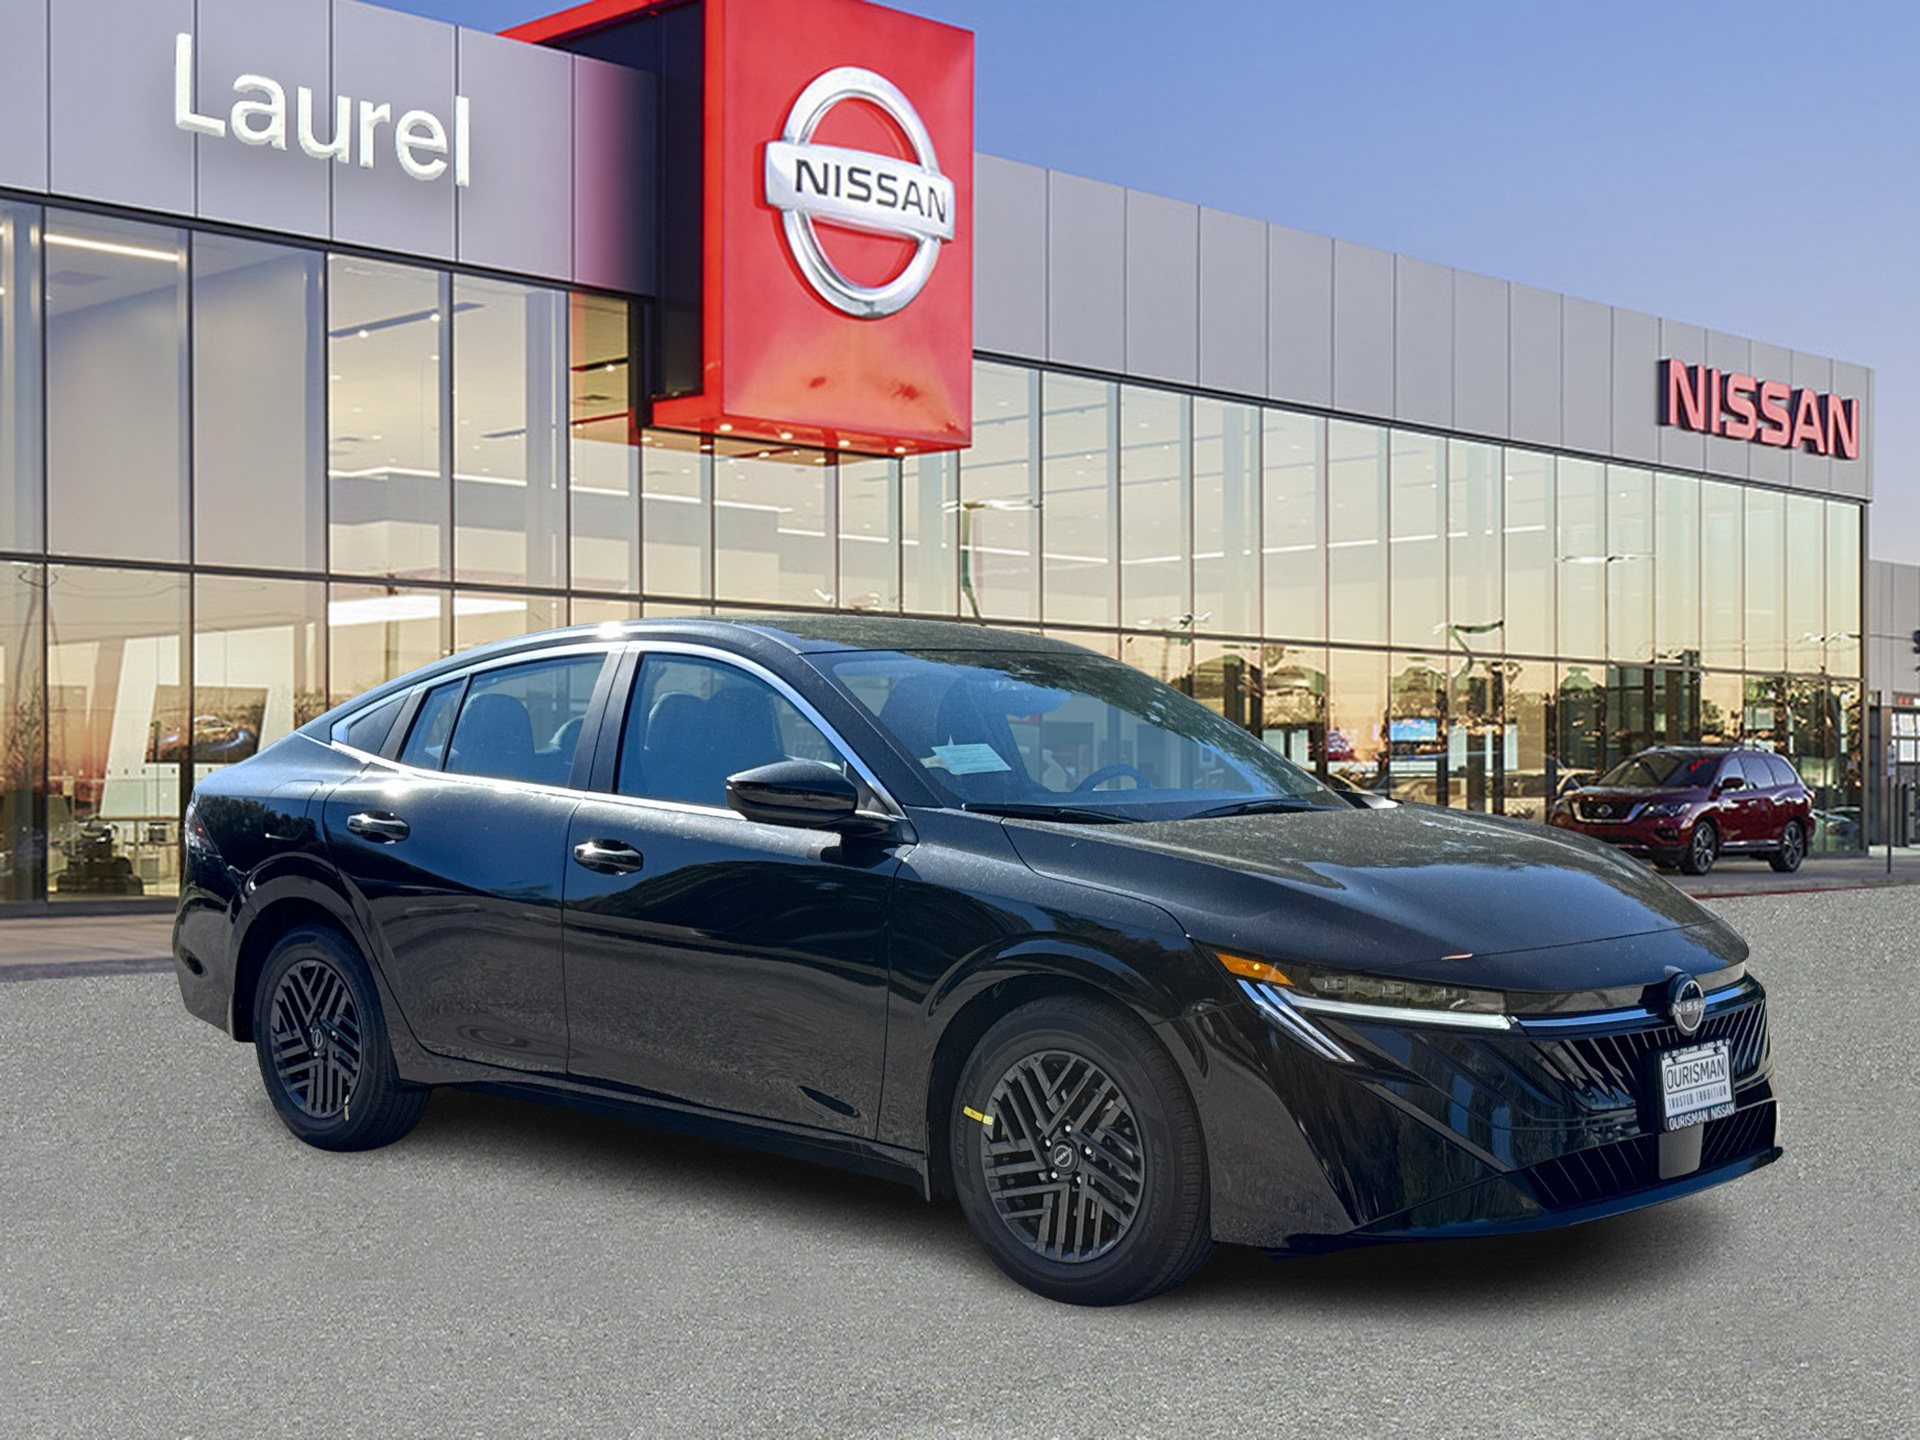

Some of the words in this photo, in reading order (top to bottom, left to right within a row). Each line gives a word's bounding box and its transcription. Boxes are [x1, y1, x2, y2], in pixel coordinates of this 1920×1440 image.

[175, 33, 470, 188] Laurel
[795, 158, 946, 223] NISSAN
[1659, 358, 1860, 460] NISSAN
[1666, 1057, 1725, 1090] OURISMAN
[1669, 1110, 1708, 1131] OURISMAN
[1710, 1102, 1735, 1121] NISSAN
